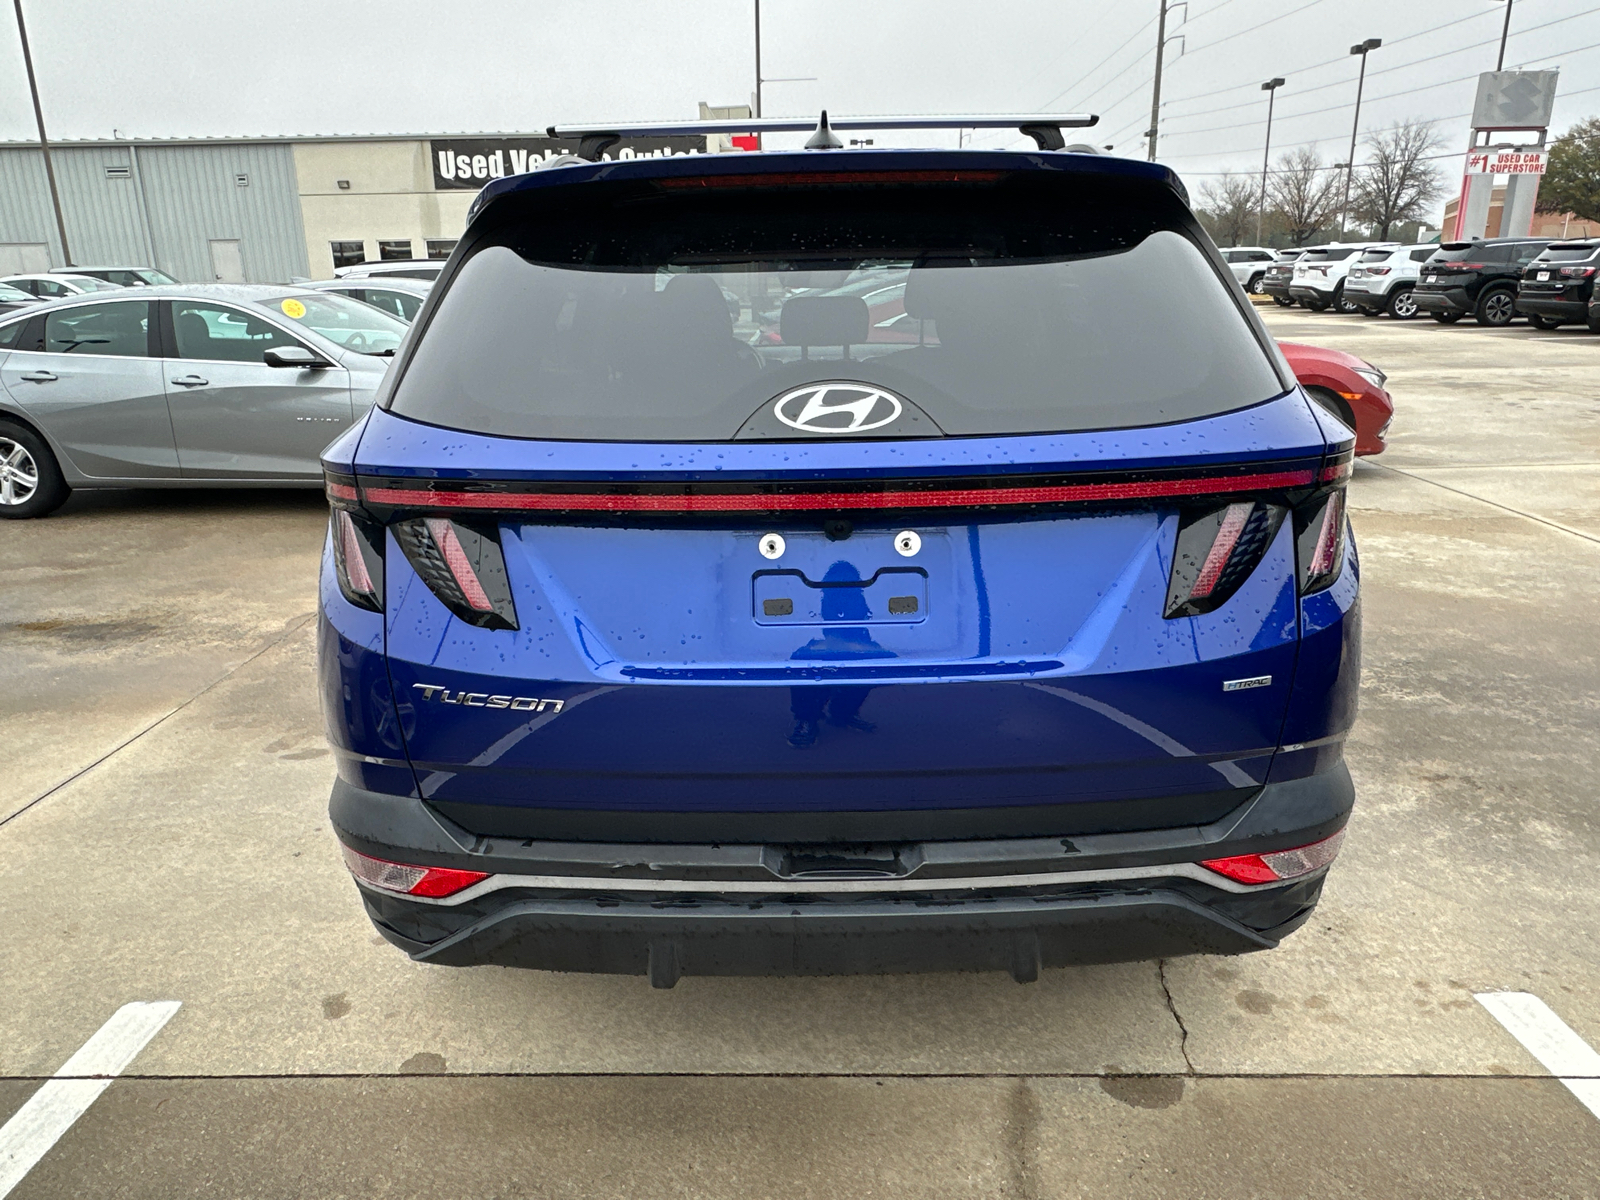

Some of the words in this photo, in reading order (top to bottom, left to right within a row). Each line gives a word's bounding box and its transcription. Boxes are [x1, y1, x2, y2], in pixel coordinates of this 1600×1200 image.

[438, 149, 504, 179] Used
[1469, 155, 1488, 173] #1
[1497, 154, 1521, 163] USED
[1523, 154, 1540, 163] CAR
[1490, 164, 1545, 173] SUPERSTORE
